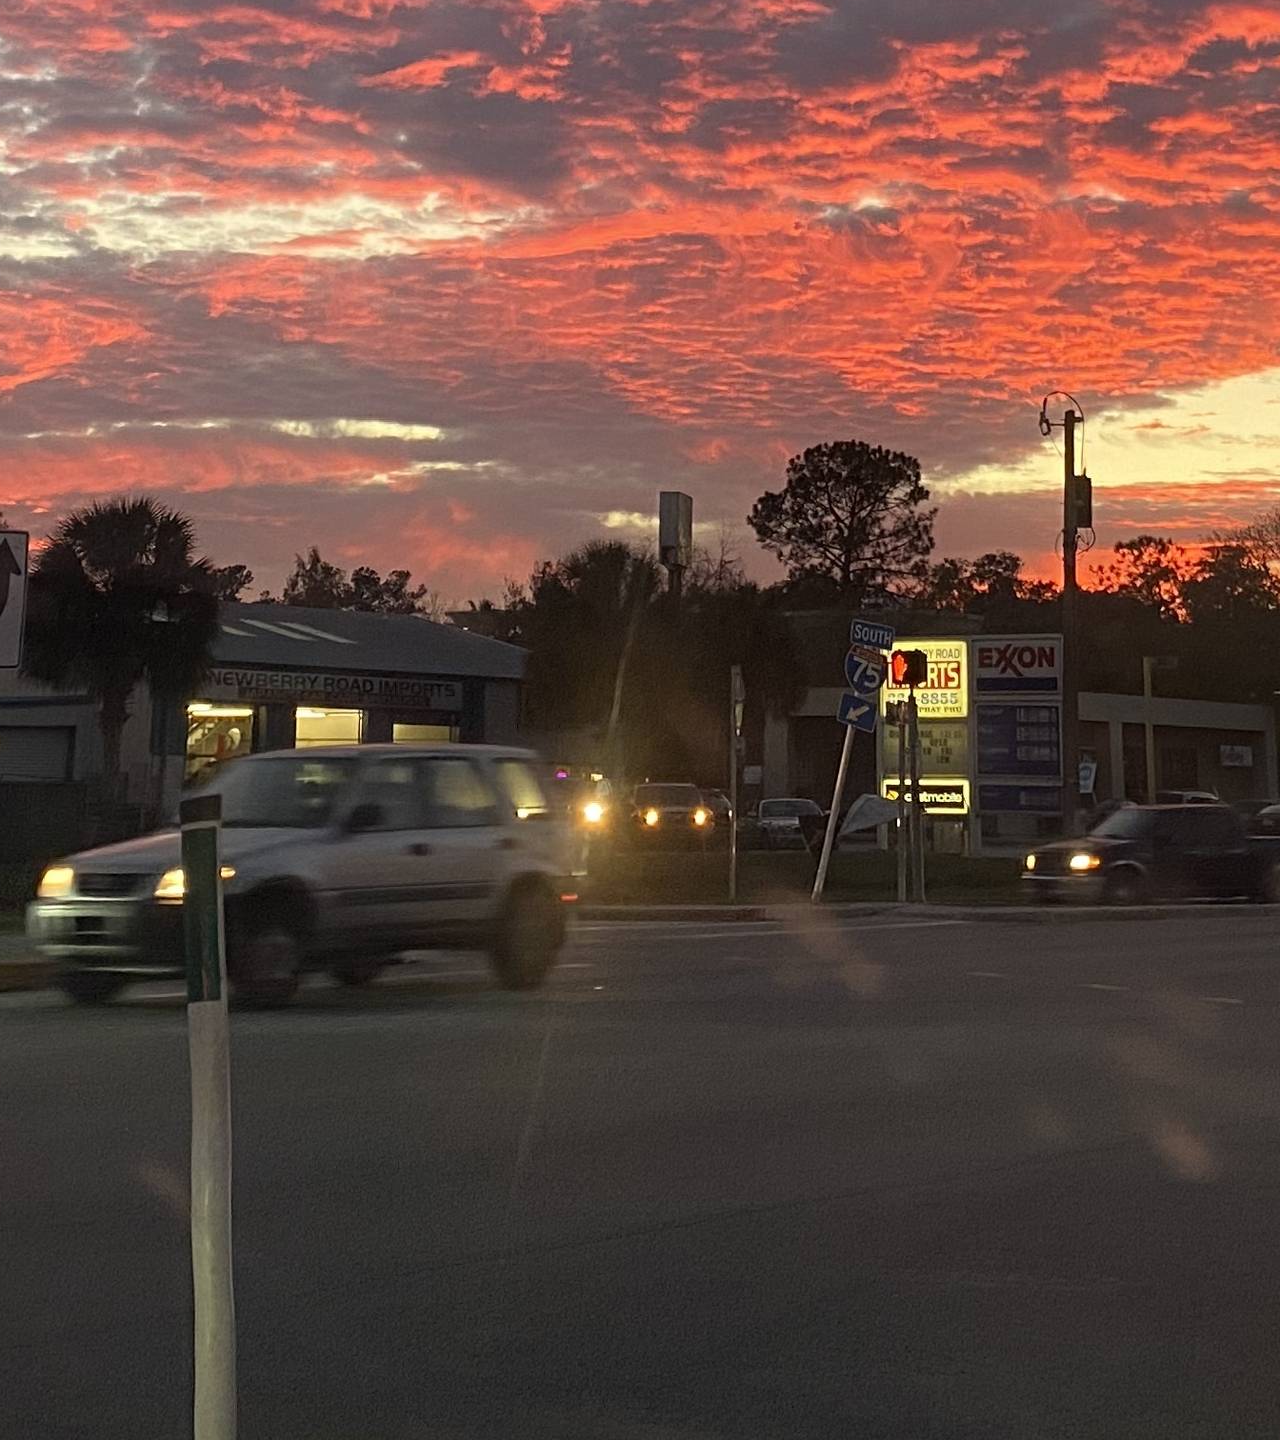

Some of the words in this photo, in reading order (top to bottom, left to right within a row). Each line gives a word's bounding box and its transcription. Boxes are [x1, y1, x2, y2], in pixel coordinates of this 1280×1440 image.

[854, 623, 893, 645] SOUTH
[936, 648, 960, 659] ROAD
[978, 643, 1054, 677] EXXON
[208, 668, 319, 690] NEWBERRY
[323, 675, 374, 693] ROAD
[378, 678, 456, 698] IMPORTS
[852, 655, 881, 688] 75
[887, 662, 960, 688] IRTS
